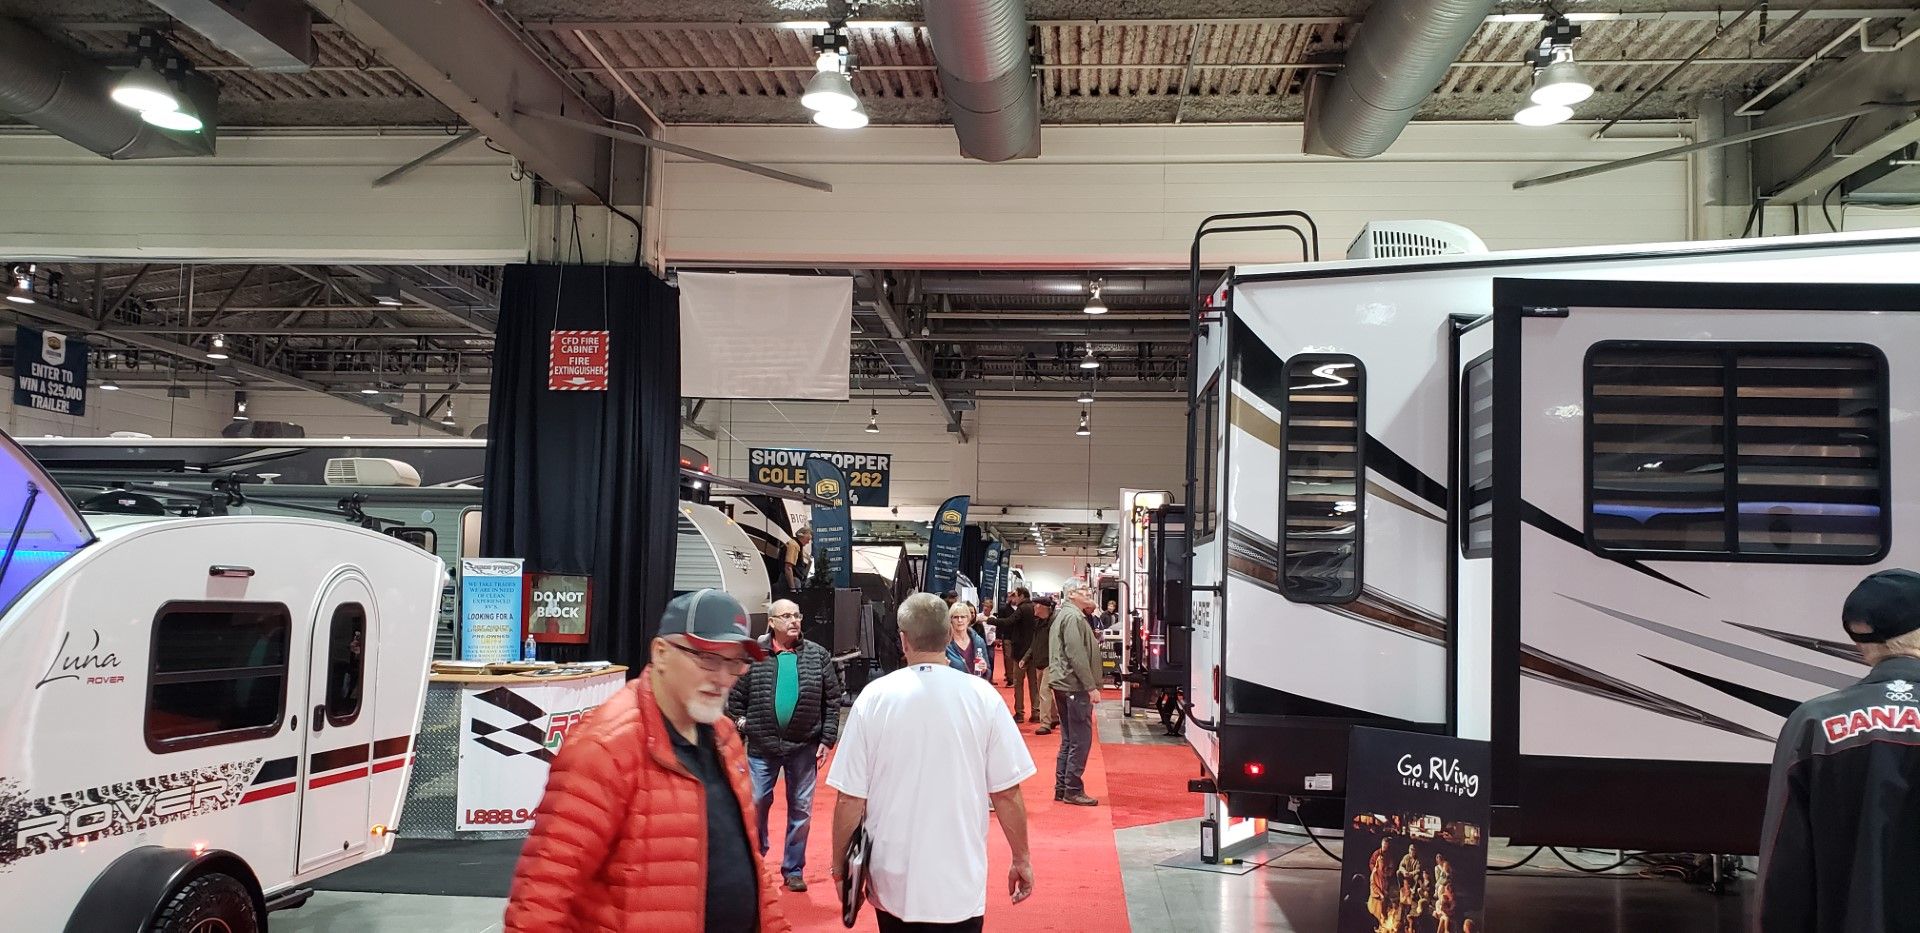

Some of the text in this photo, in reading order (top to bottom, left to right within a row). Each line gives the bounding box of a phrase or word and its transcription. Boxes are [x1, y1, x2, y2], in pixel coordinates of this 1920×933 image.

[561, 337, 599, 345] CFD FIRE
[561, 345, 599, 354] CABINET
[569, 356, 590, 366] FIRE
[31, 362, 73, 383] ENTER TO
[554, 366, 604, 375] EXTINGUISHER
[19, 375, 83, 401] WIN A $25,000
[30, 393, 70, 413] TRAILER!
[751, 450, 806, 467] SHOW
[849, 471, 883, 488] 262
[533, 591, 585, 603] DO NOT
[467, 612, 514, 621] LOOKING FOR A
[536, 606, 580, 618] BLOCK
[35, 629, 121, 690] Luna
[87, 675, 125, 685] ROVER
[1397, 754, 1479, 798] Go RVing
[1402, 777, 1428, 789] Life's
[1433, 782, 1440, 791] A
[15, 779, 231, 849] ROVER
